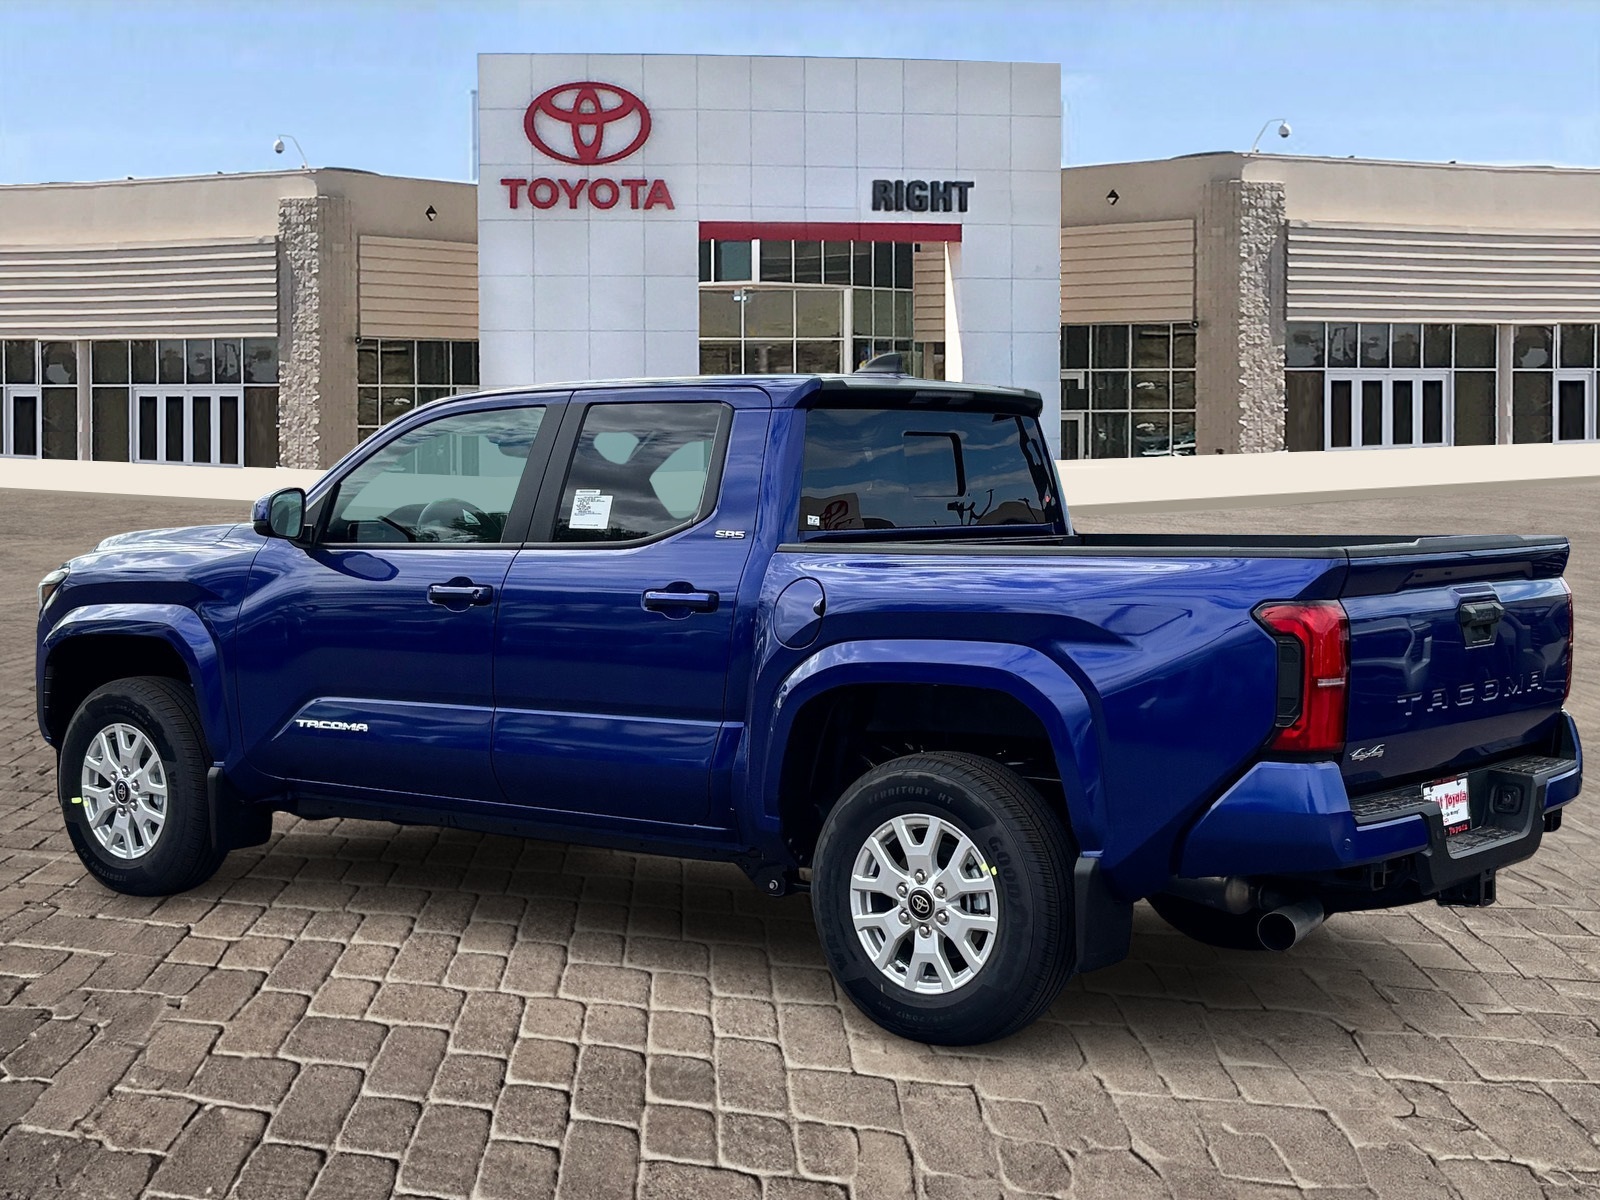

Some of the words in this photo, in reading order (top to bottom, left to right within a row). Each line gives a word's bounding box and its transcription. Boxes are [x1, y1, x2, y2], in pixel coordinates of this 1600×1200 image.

[500, 178, 675, 211] TOYOTA
[872, 179, 975, 212] RIGHT
[714, 529, 746, 539] SR5
[1397, 671, 1542, 716] TACOMA
[295, 719, 369, 732] TACOMA
